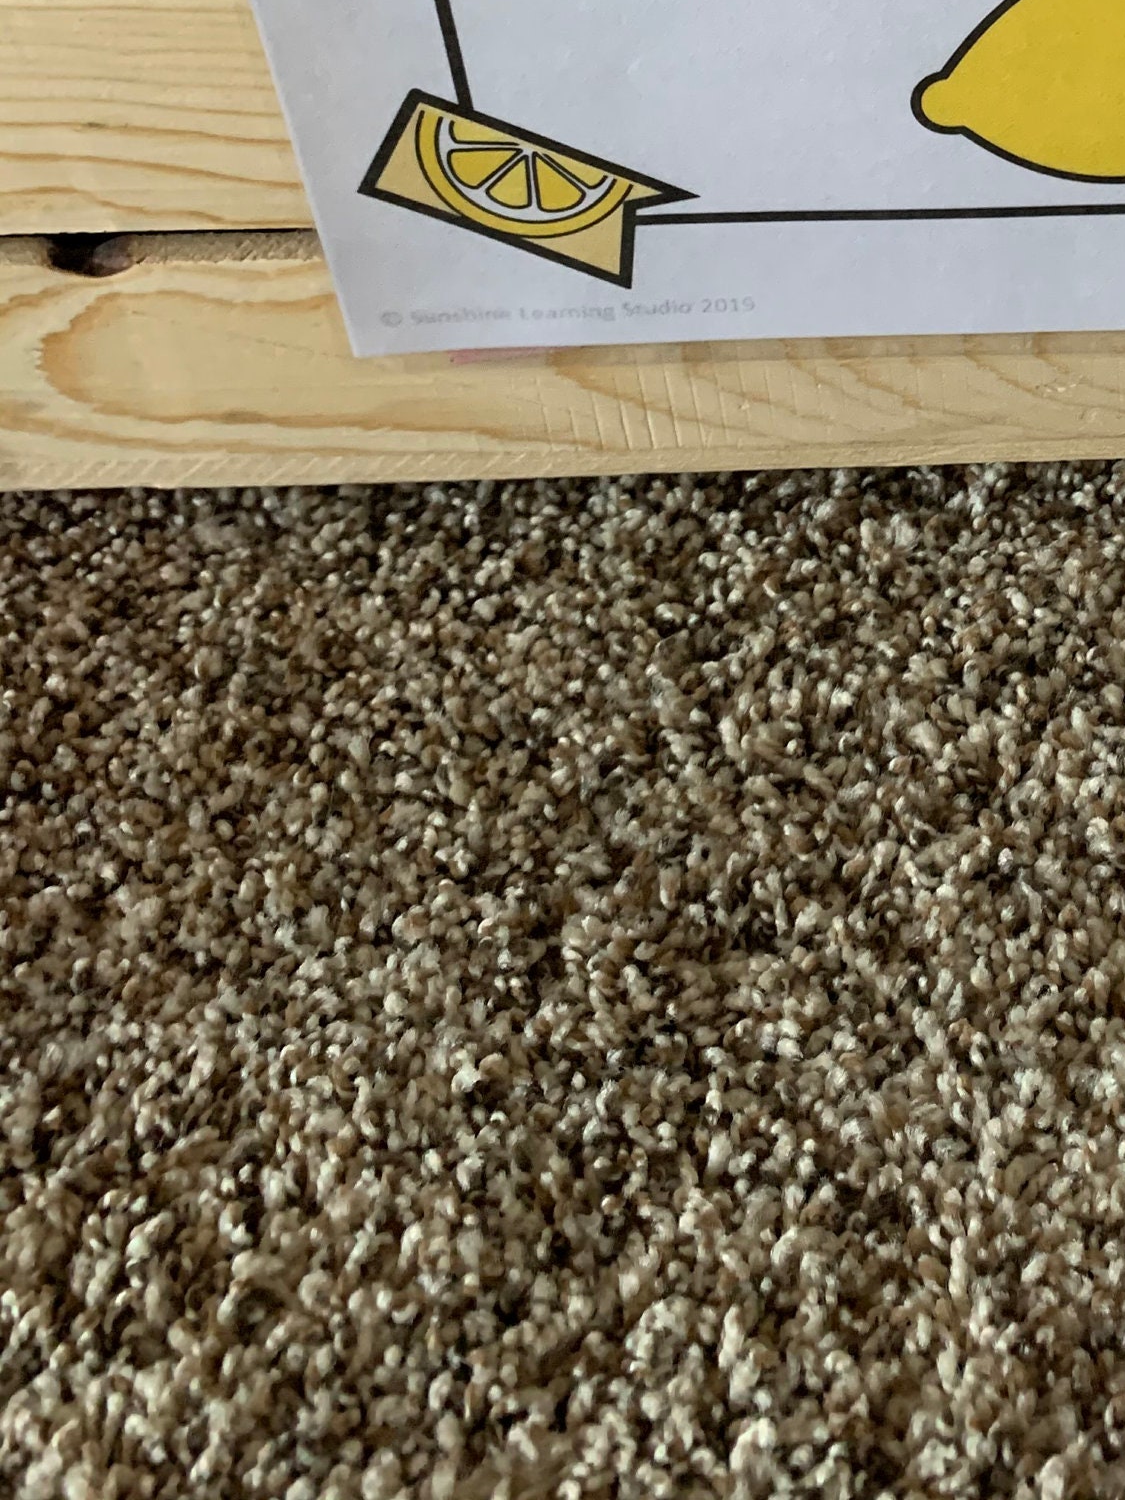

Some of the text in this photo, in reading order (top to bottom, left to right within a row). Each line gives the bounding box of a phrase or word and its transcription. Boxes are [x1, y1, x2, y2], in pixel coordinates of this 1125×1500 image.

[410, 307, 510, 326] Sunshine
[519, 303, 617, 324] Learning
[622, 299, 692, 318] Studio
